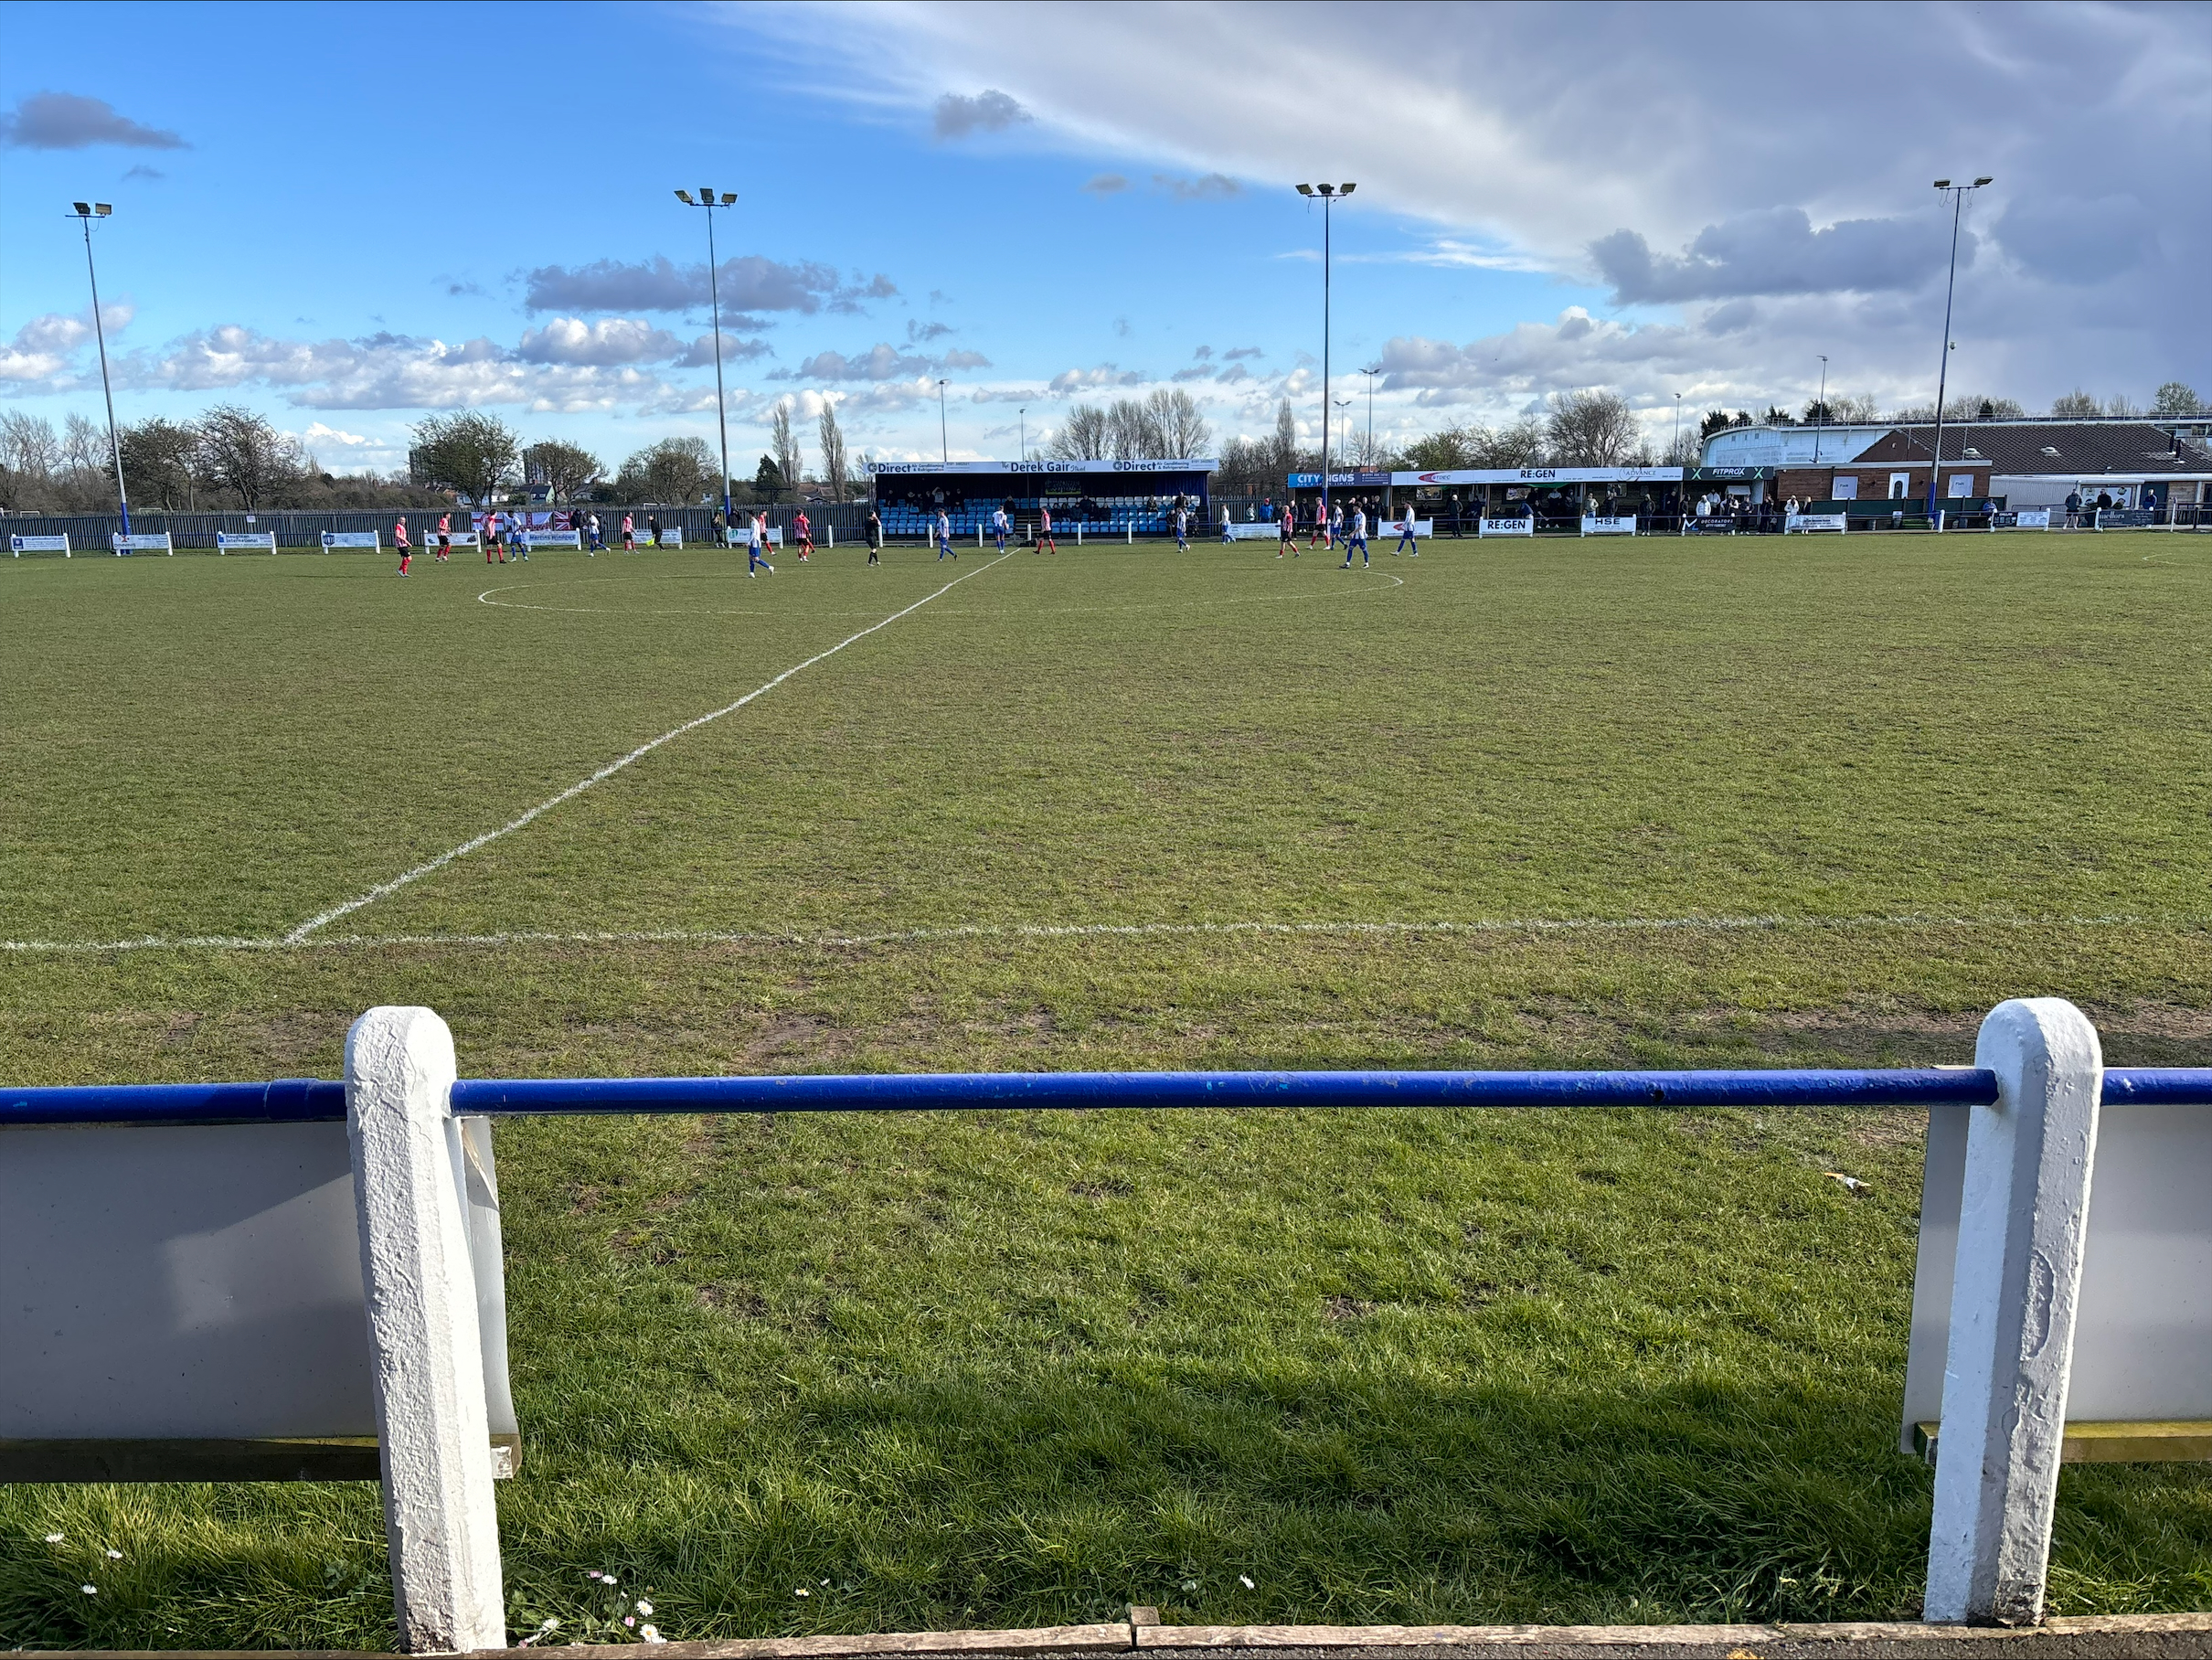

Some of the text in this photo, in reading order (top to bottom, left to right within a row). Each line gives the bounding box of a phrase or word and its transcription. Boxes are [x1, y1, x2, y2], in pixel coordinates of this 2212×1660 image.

[877, 463, 911, 473] Direct
[1011, 462, 1044, 472] Derek
[1047, 461, 1070, 472] Gair
[1123, 461, 1156, 471] Direct
[1520, 469, 1556, 478] RE:GEN
[1712, 467, 1746, 475] FITPROX
[1297, 474, 1319, 483] CITY
[1487, 520, 1526, 529] RE:GEN
[1595, 517, 1621, 526] HSE
